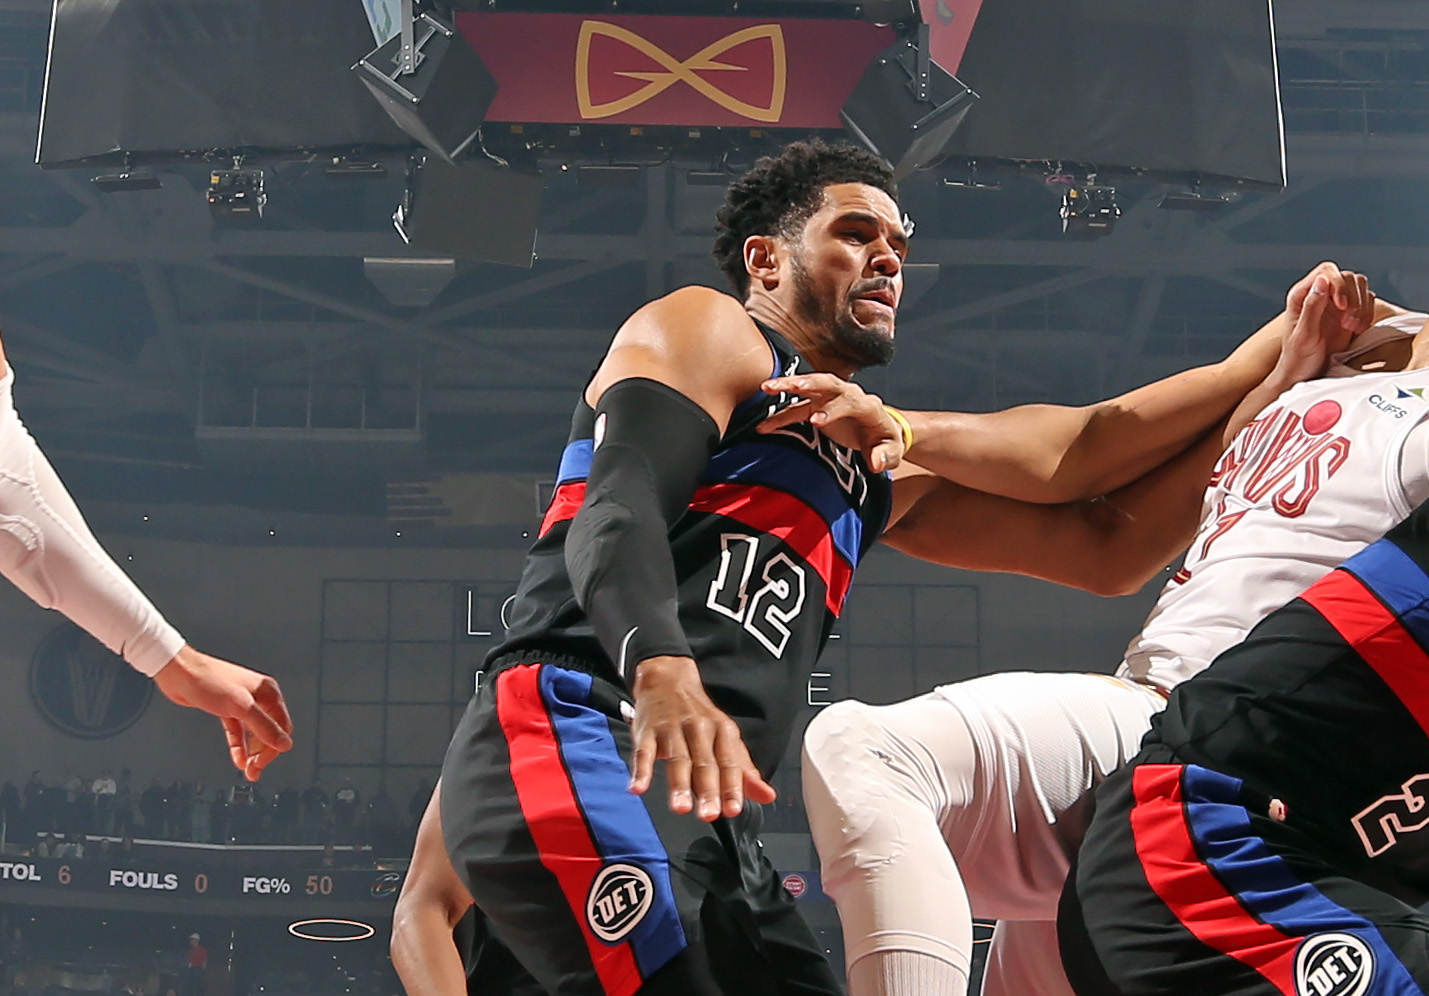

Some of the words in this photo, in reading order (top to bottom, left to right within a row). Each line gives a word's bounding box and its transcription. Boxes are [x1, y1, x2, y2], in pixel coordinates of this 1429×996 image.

[1368, 394, 1408, 420] CLIFFS
[706, 532, 806, 660] 12
[0, 863, 41, 881] TOL
[57, 866, 71, 885] 6
[109, 870, 179, 892] FOULS
[193, 874, 208, 893] 0
[242, 877, 291, 896] FG%
[305, 876, 334, 895] 50
[595, 880, 640, 924] DET
